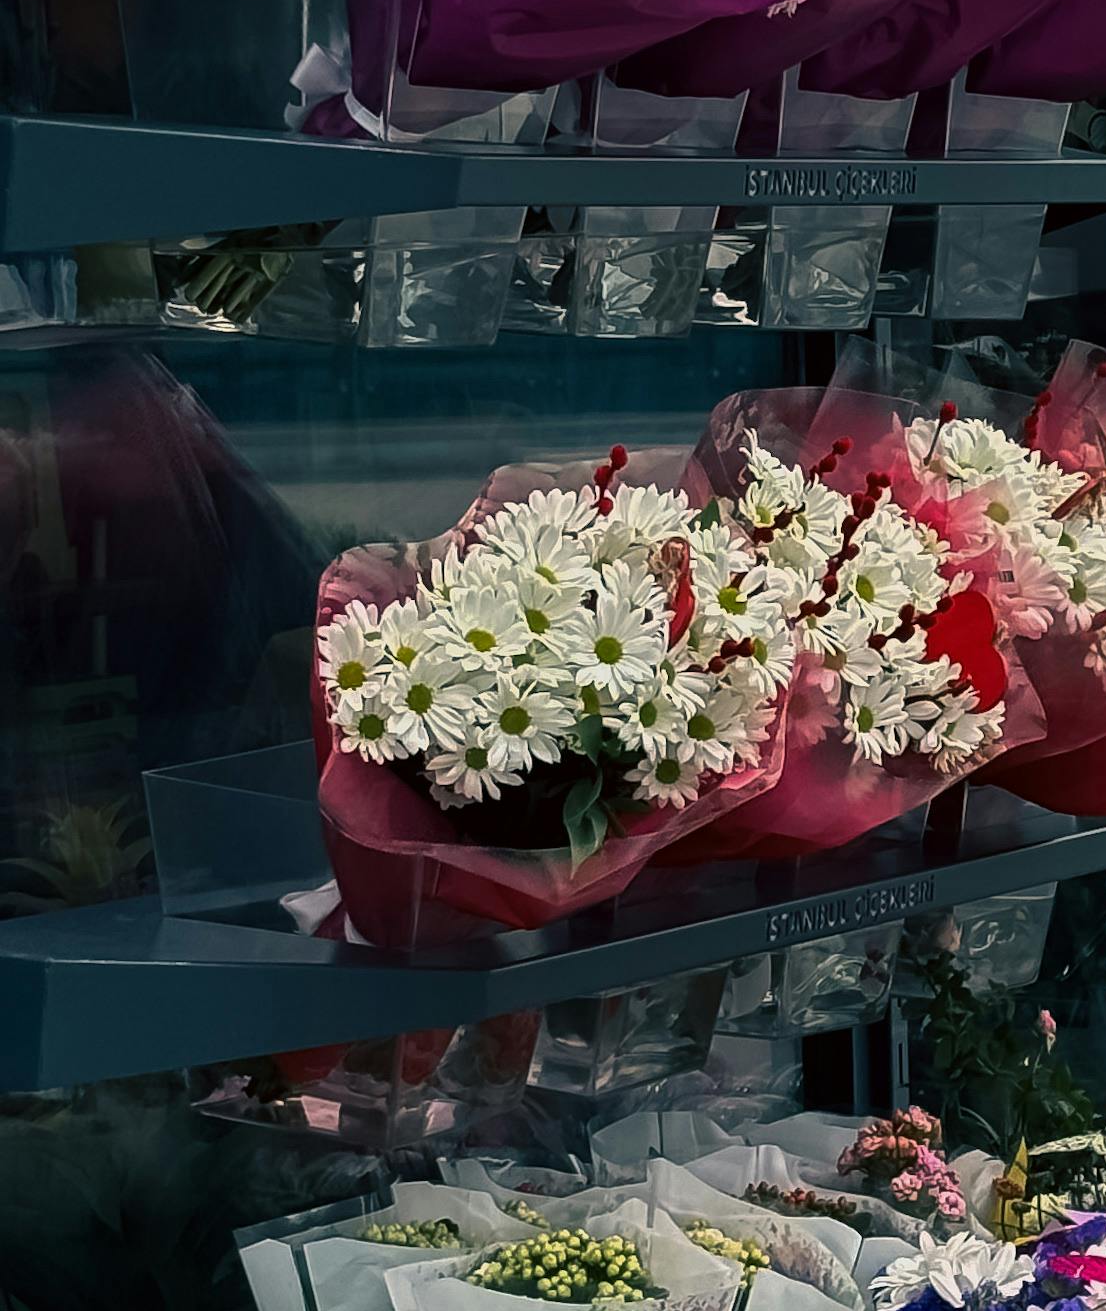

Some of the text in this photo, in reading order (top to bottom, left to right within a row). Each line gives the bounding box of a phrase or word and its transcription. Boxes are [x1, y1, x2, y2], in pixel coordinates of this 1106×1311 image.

[744, 165, 918, 201] İSTANBUL ÇİÇEKLERİ
[766, 875, 936, 941] İSTANBUL ÇİÇEKLERİ
